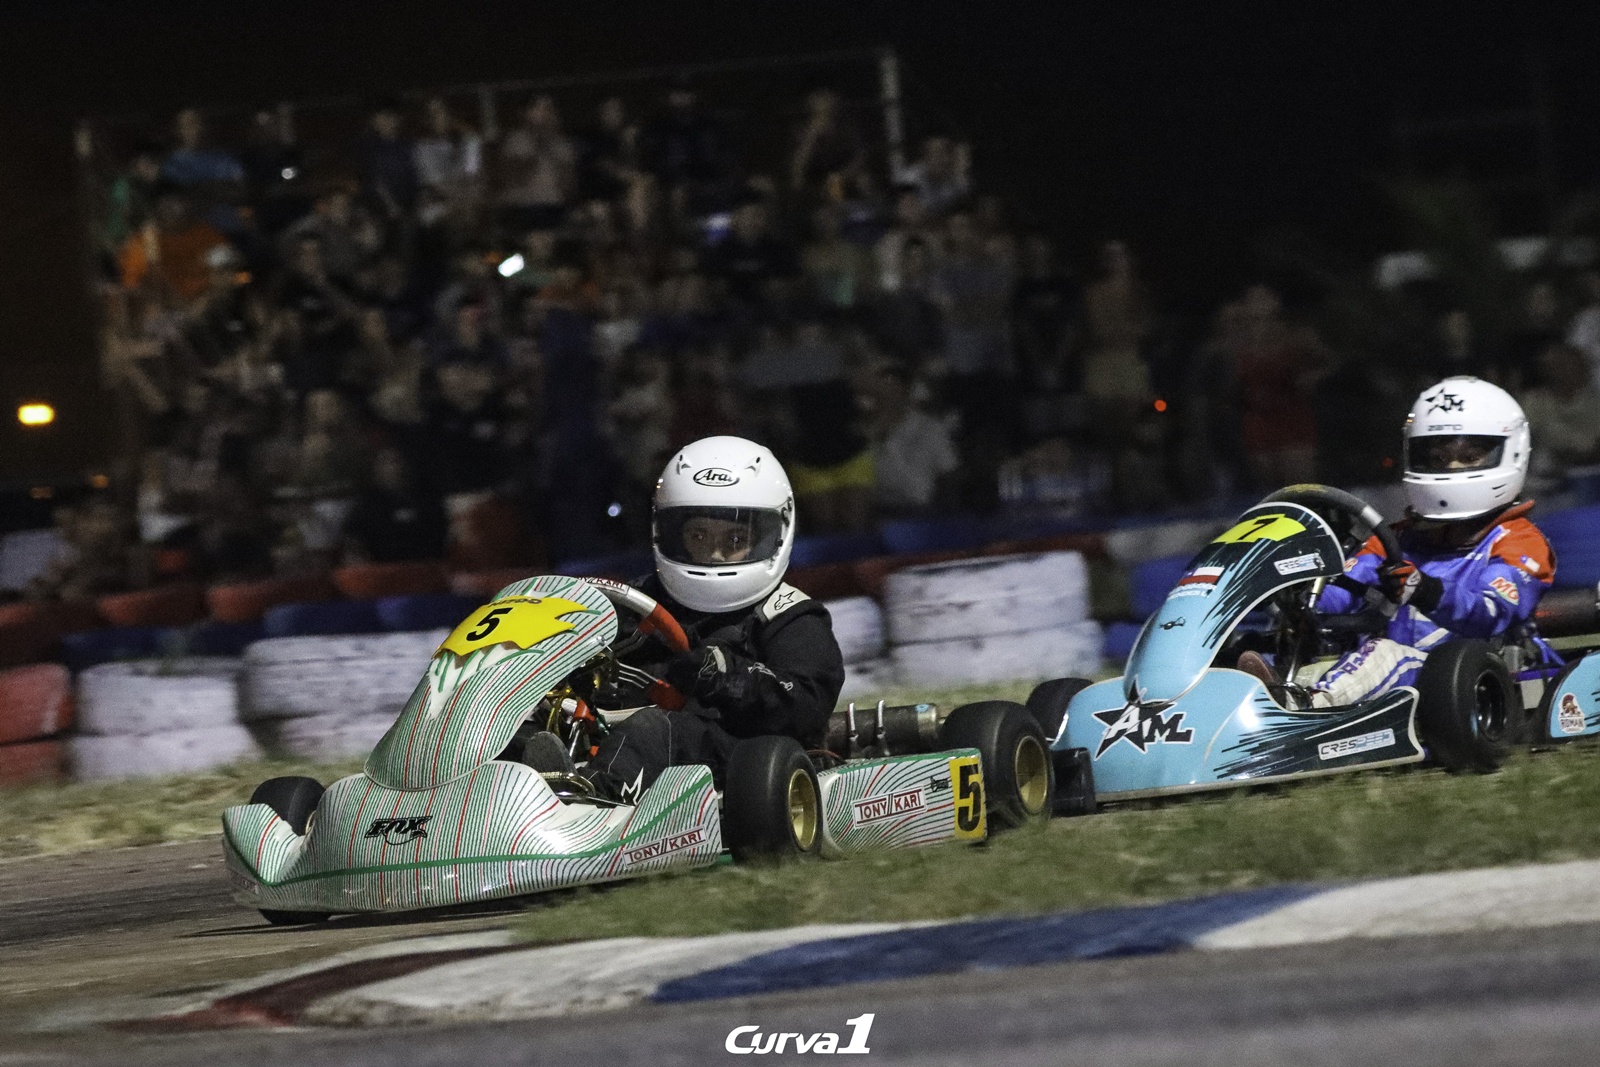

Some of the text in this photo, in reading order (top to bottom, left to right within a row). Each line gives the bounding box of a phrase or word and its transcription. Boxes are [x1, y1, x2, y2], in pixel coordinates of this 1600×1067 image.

[1237, 516, 1280, 541] 7
[466, 607, 513, 641] 5
[957, 764, 982, 832] 5
